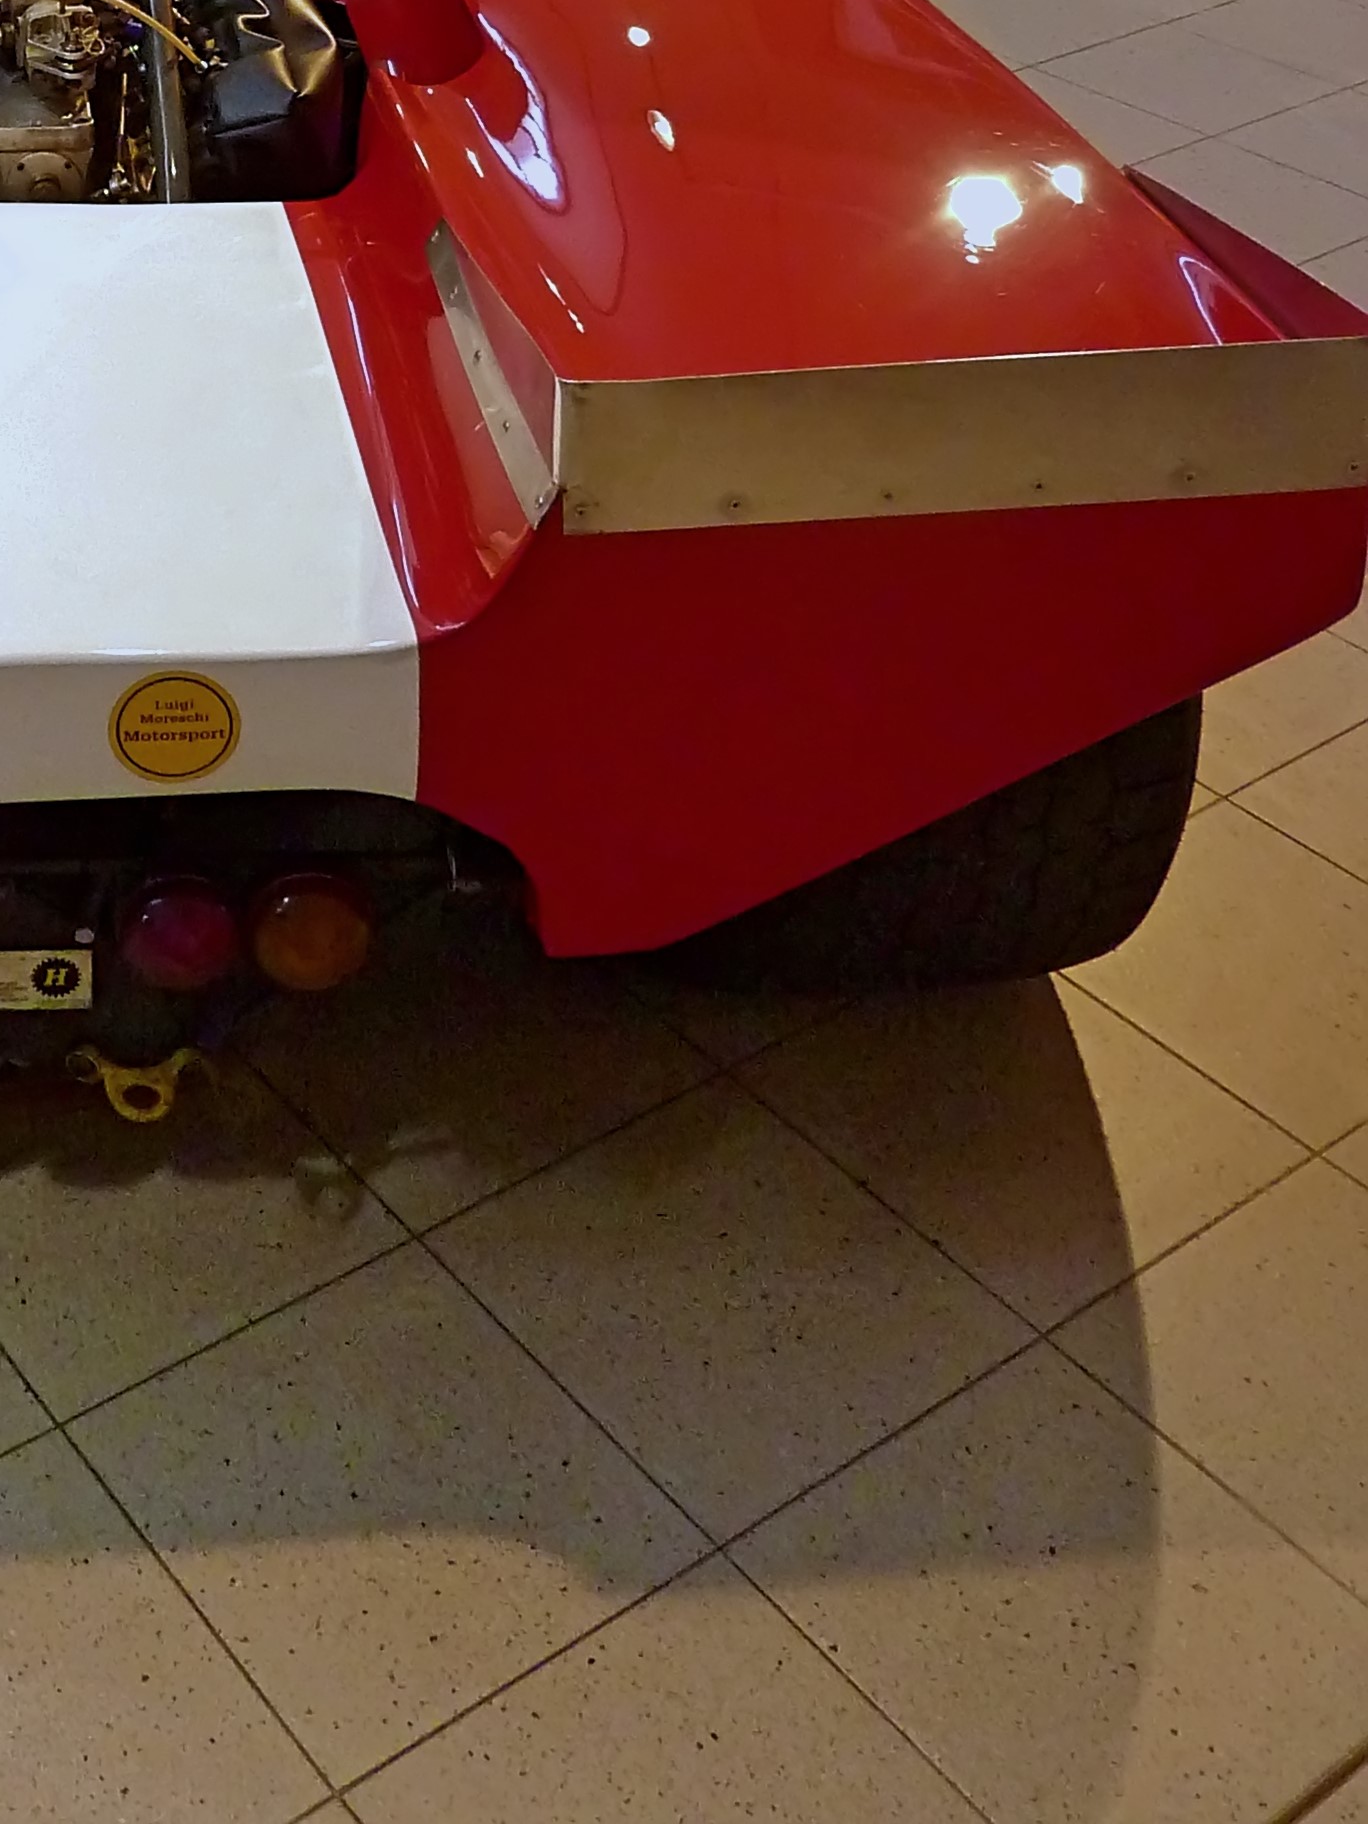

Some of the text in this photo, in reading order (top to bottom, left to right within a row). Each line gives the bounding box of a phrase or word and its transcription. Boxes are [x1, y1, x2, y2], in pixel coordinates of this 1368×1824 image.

[155, 698, 194, 711] Luigi
[140, 712, 210, 725] Moreschi
[123, 728, 227, 743] Motorsport
